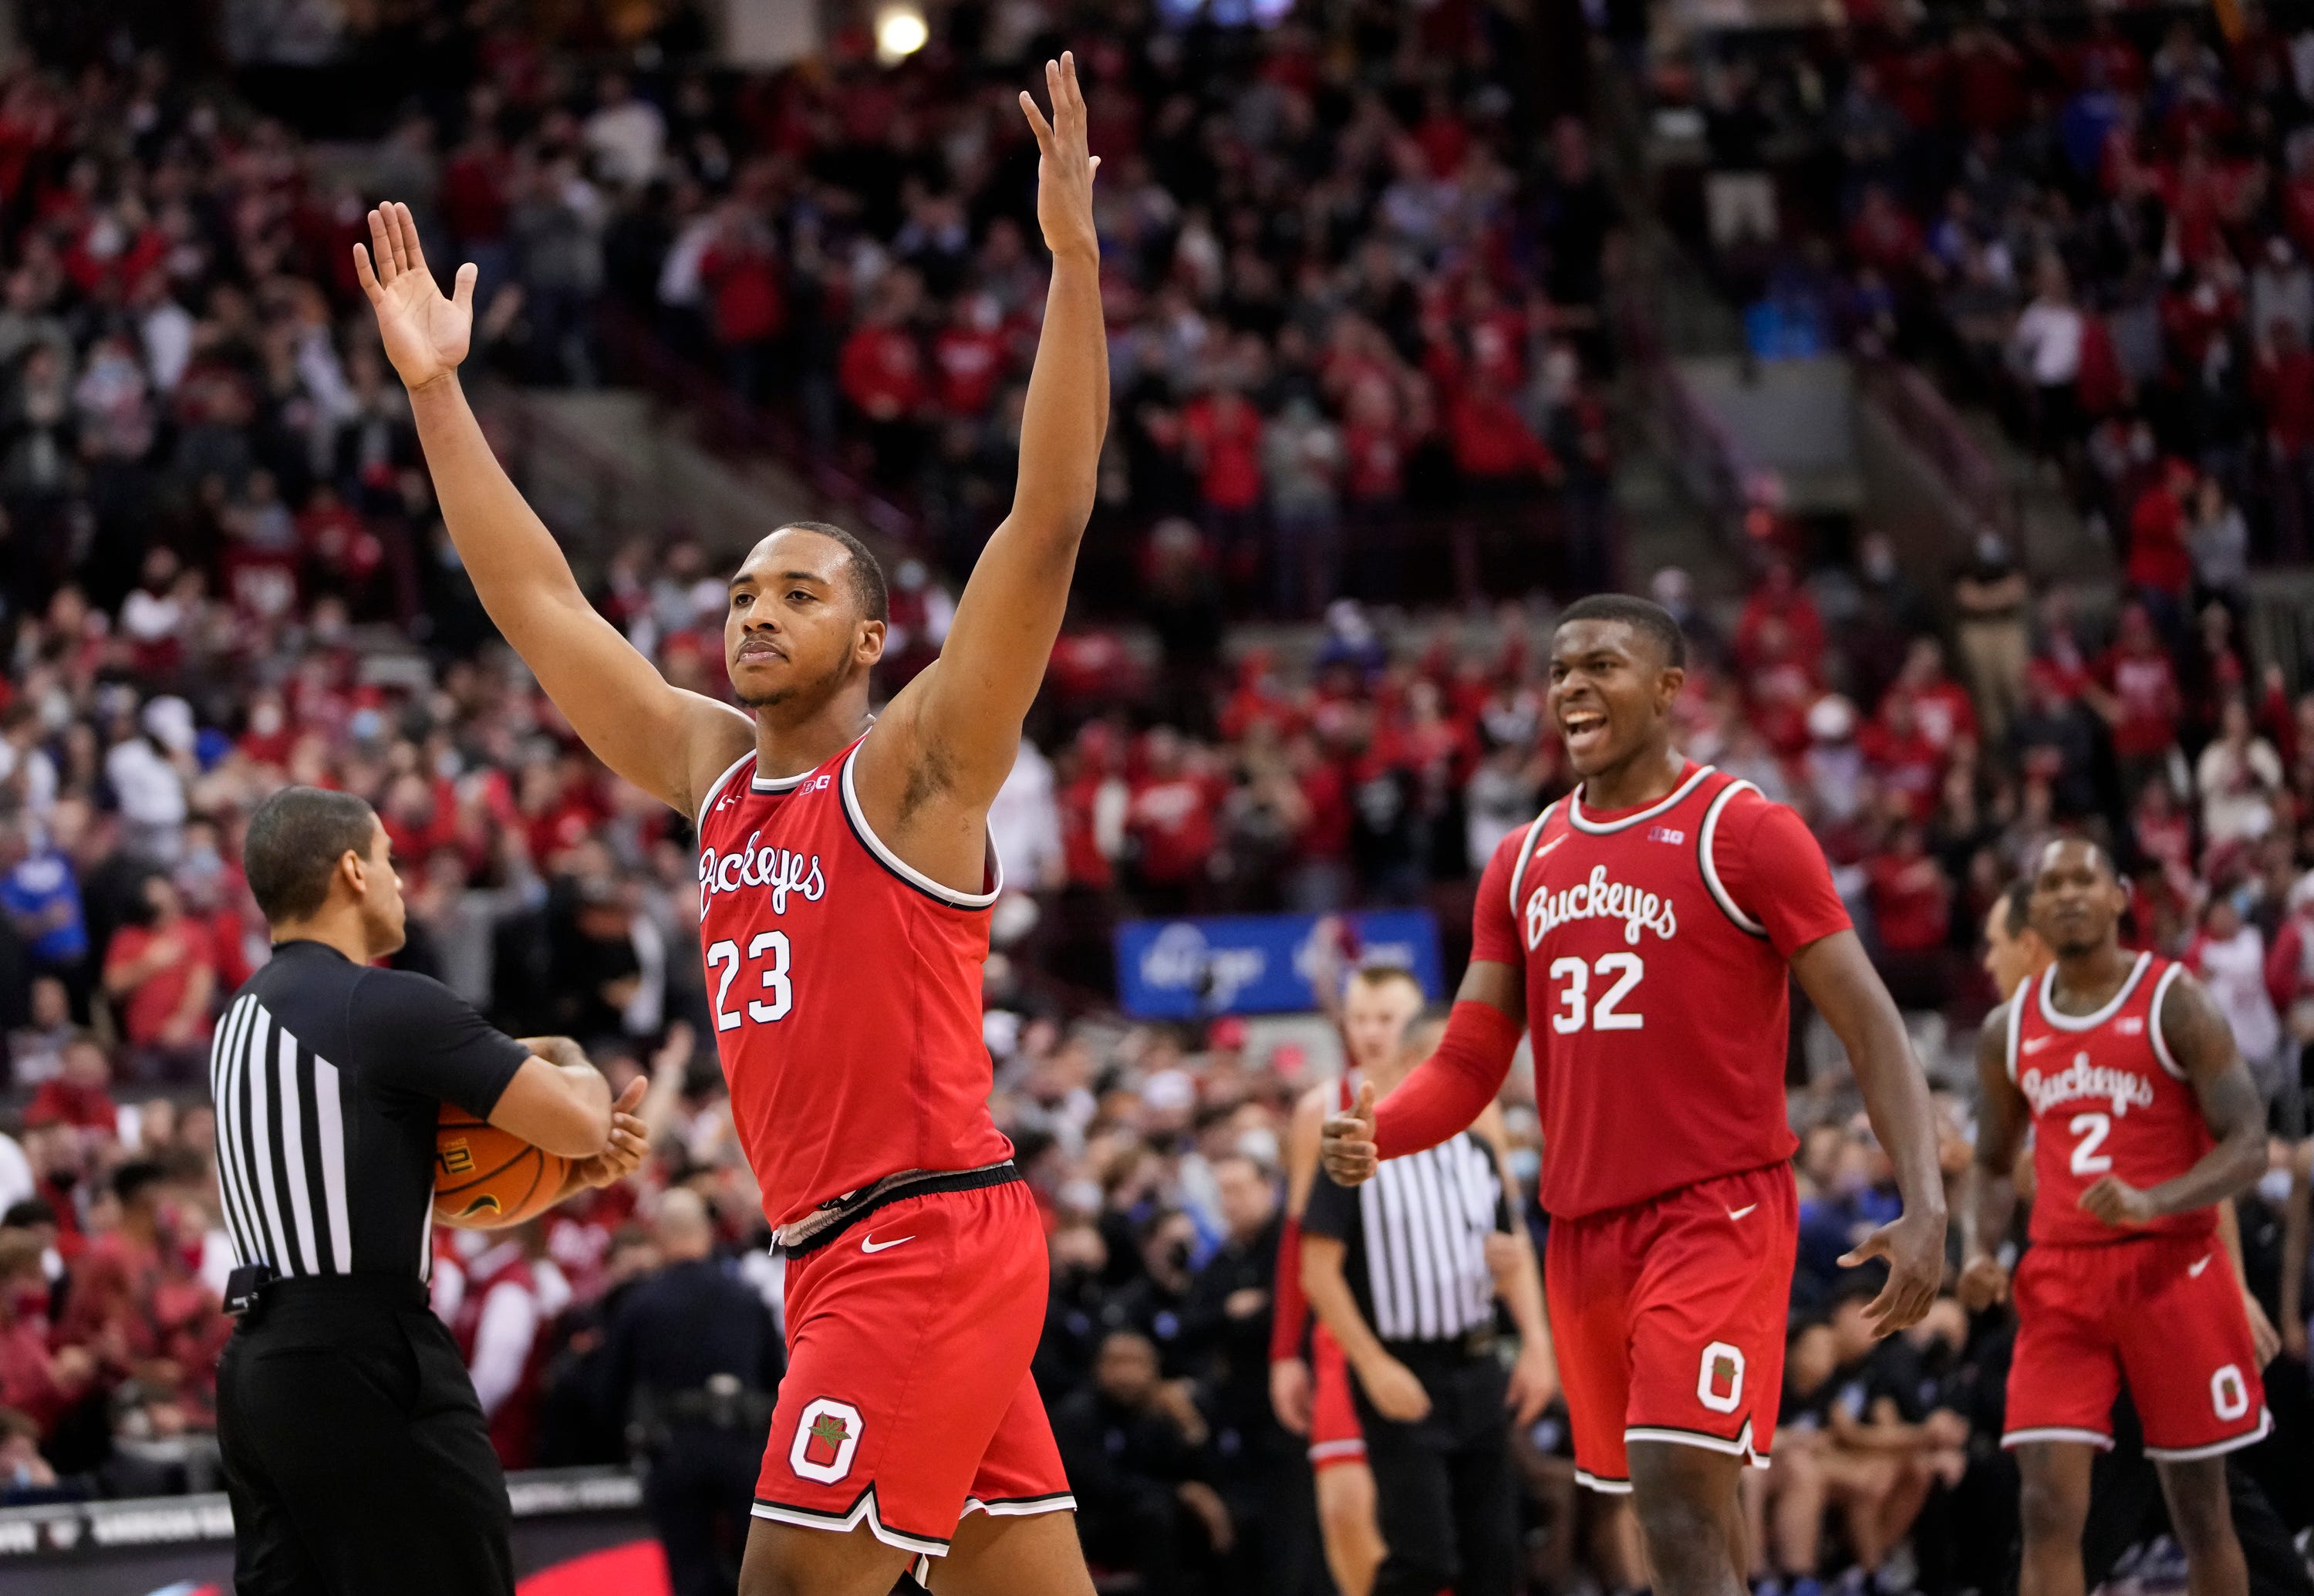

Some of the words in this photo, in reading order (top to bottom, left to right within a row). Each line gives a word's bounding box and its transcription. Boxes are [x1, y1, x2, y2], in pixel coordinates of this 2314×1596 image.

[1526, 864, 1677, 952] Buckeyes
[707, 930, 793, 1032] 23
[1550, 952, 1644, 1034] 32
[2069, 1112, 2113, 1176] 2
